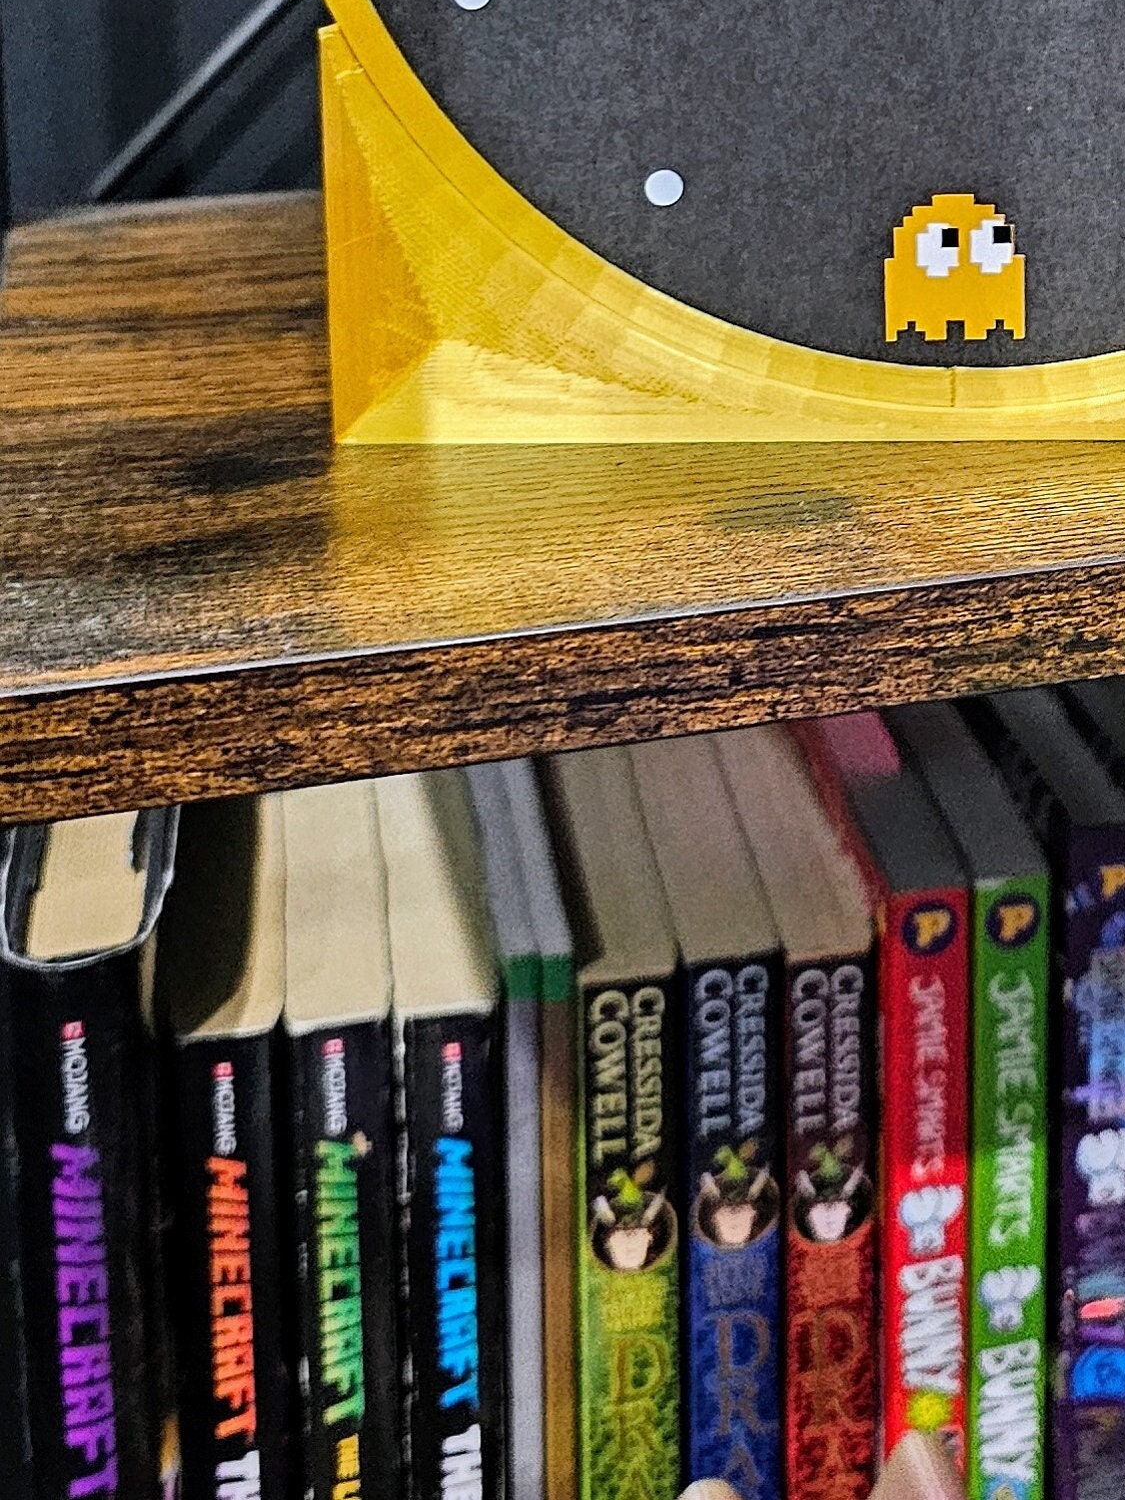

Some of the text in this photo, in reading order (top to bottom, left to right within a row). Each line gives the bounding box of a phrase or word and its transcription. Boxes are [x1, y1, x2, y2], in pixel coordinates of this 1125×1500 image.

[62, 1036, 91, 1135] MOJANG
[589, 989, 630, 1167] COWELL
[632, 986, 666, 1161] CRESSIDA
[697, 968, 734, 1137] COWELL
[736, 964, 769, 1135] CRESSIDA
[793, 968, 830, 1136] COWELL
[831, 964, 864, 1132] CRESSIDA
[50, 1142, 119, 1499] MINECRAFT
[205, 1155, 258, 1444] MINECRAFT
[315, 1138, 365, 1428] MINECRAFT
[434, 1137, 481, 1410] MINECRAFT
[899, 1254, 965, 1394] BUNNY
[979, 1338, 1041, 1484] BUNNY
